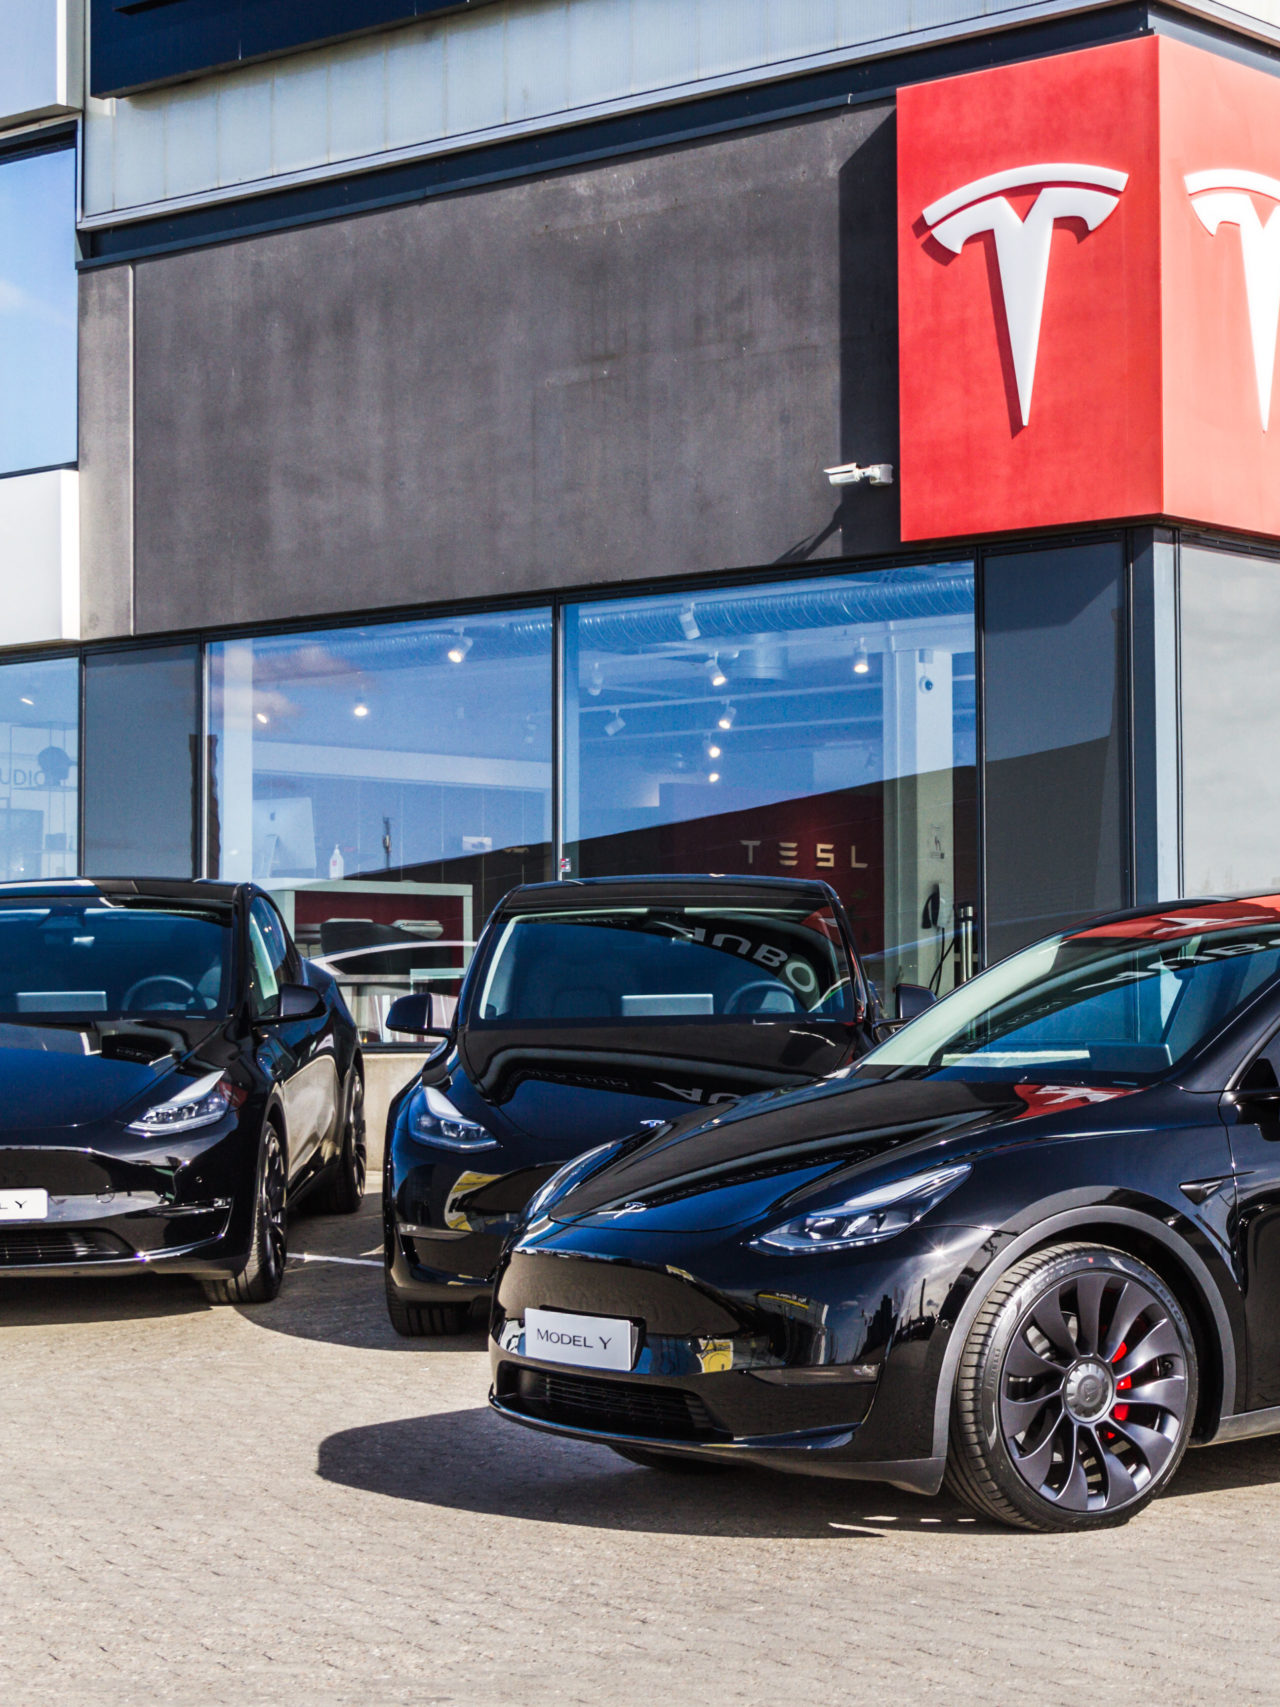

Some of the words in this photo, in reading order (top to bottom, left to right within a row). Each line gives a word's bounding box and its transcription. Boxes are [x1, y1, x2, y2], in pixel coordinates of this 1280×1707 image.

[740, 839, 869, 870] TESL
[15, 1200, 28, 1209] Y
[536, 1328, 594, 1349] MODEL
[598, 1336, 612, 1350] Y
